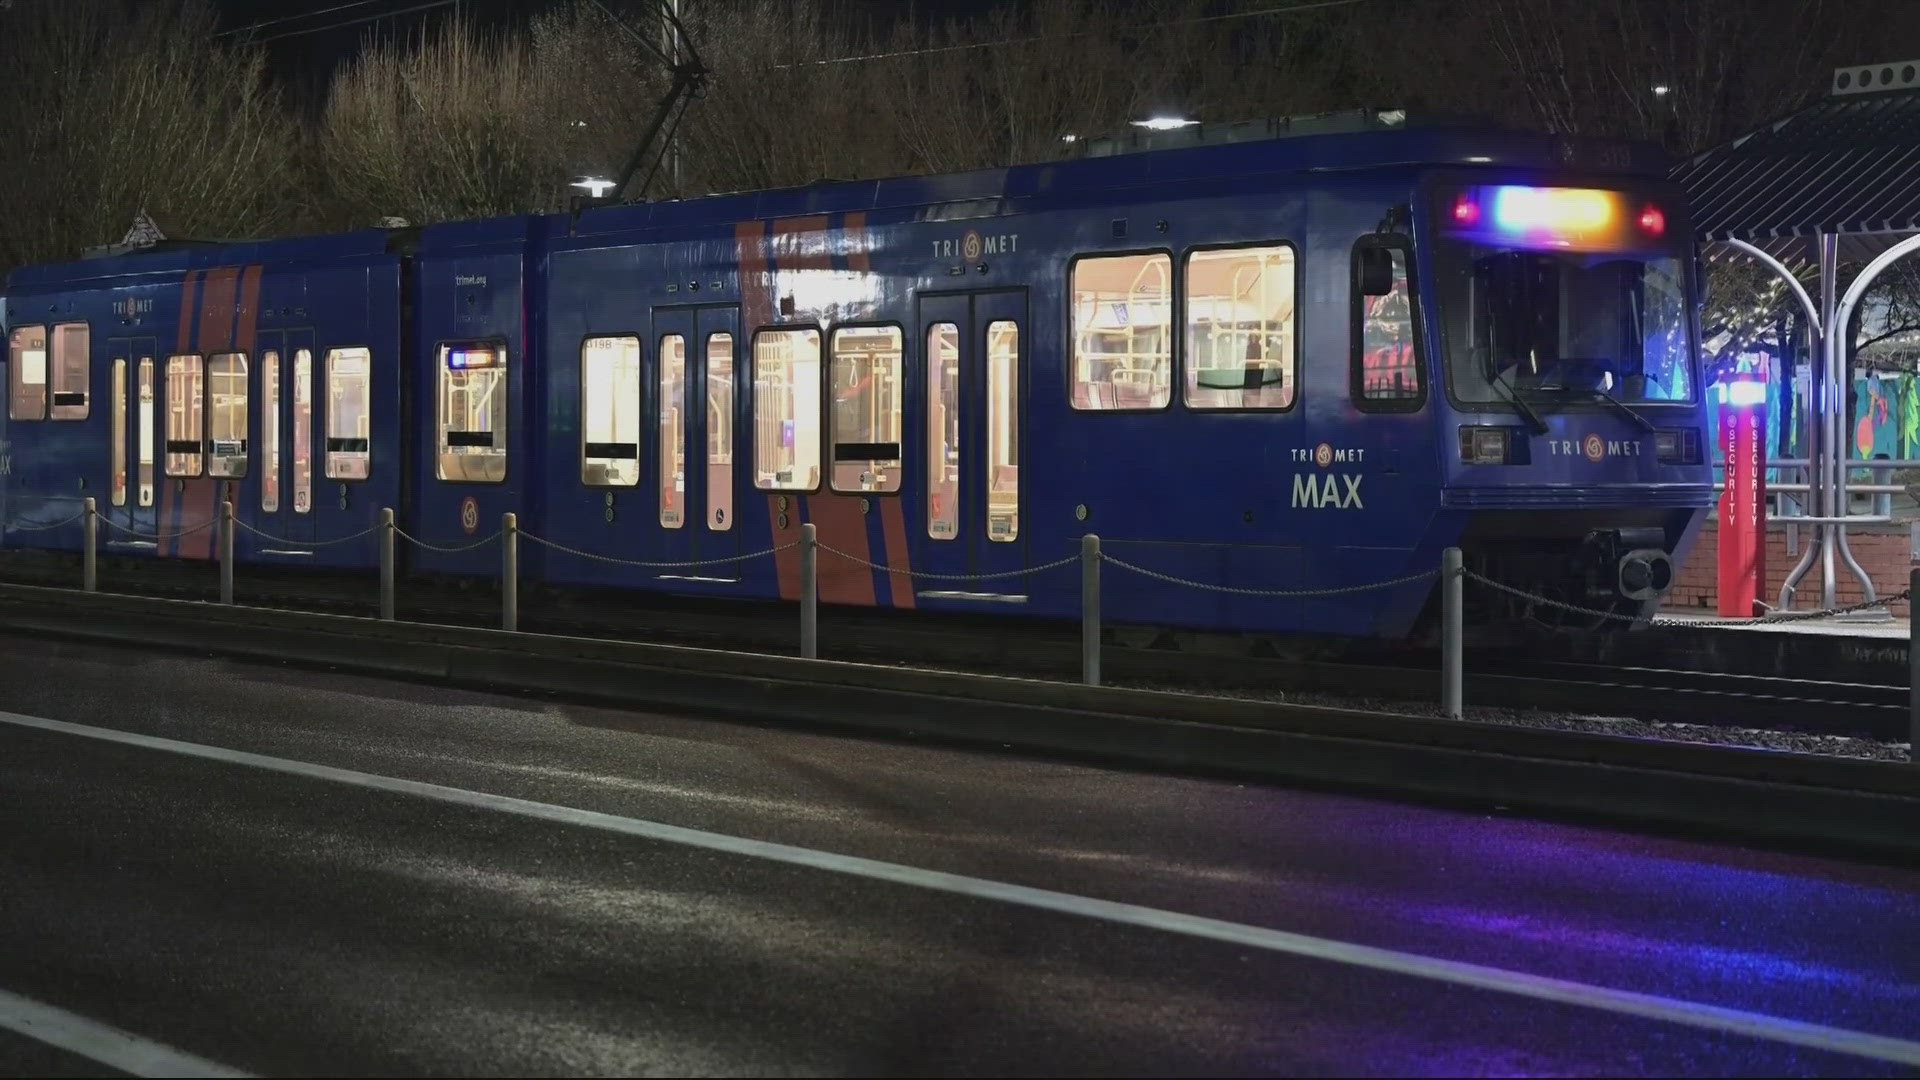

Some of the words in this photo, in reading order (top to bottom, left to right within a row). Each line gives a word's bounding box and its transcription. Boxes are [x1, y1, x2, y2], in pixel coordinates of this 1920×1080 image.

[932, 239, 959, 258] TRI
[984, 234, 1018, 254] MET
[455, 274, 487, 288] trimet.org
[112, 301, 126, 315] TRI
[136, 299, 153, 313] MET
[1291, 448, 1313, 462] TRI
[1334, 448, 1364, 462] MET
[1549, 440, 1580, 455] TRI
[1608, 440, 1641, 456] MET
[1728, 429, 1736, 526] SECURITY
[1291, 473, 1363, 509] MAX
